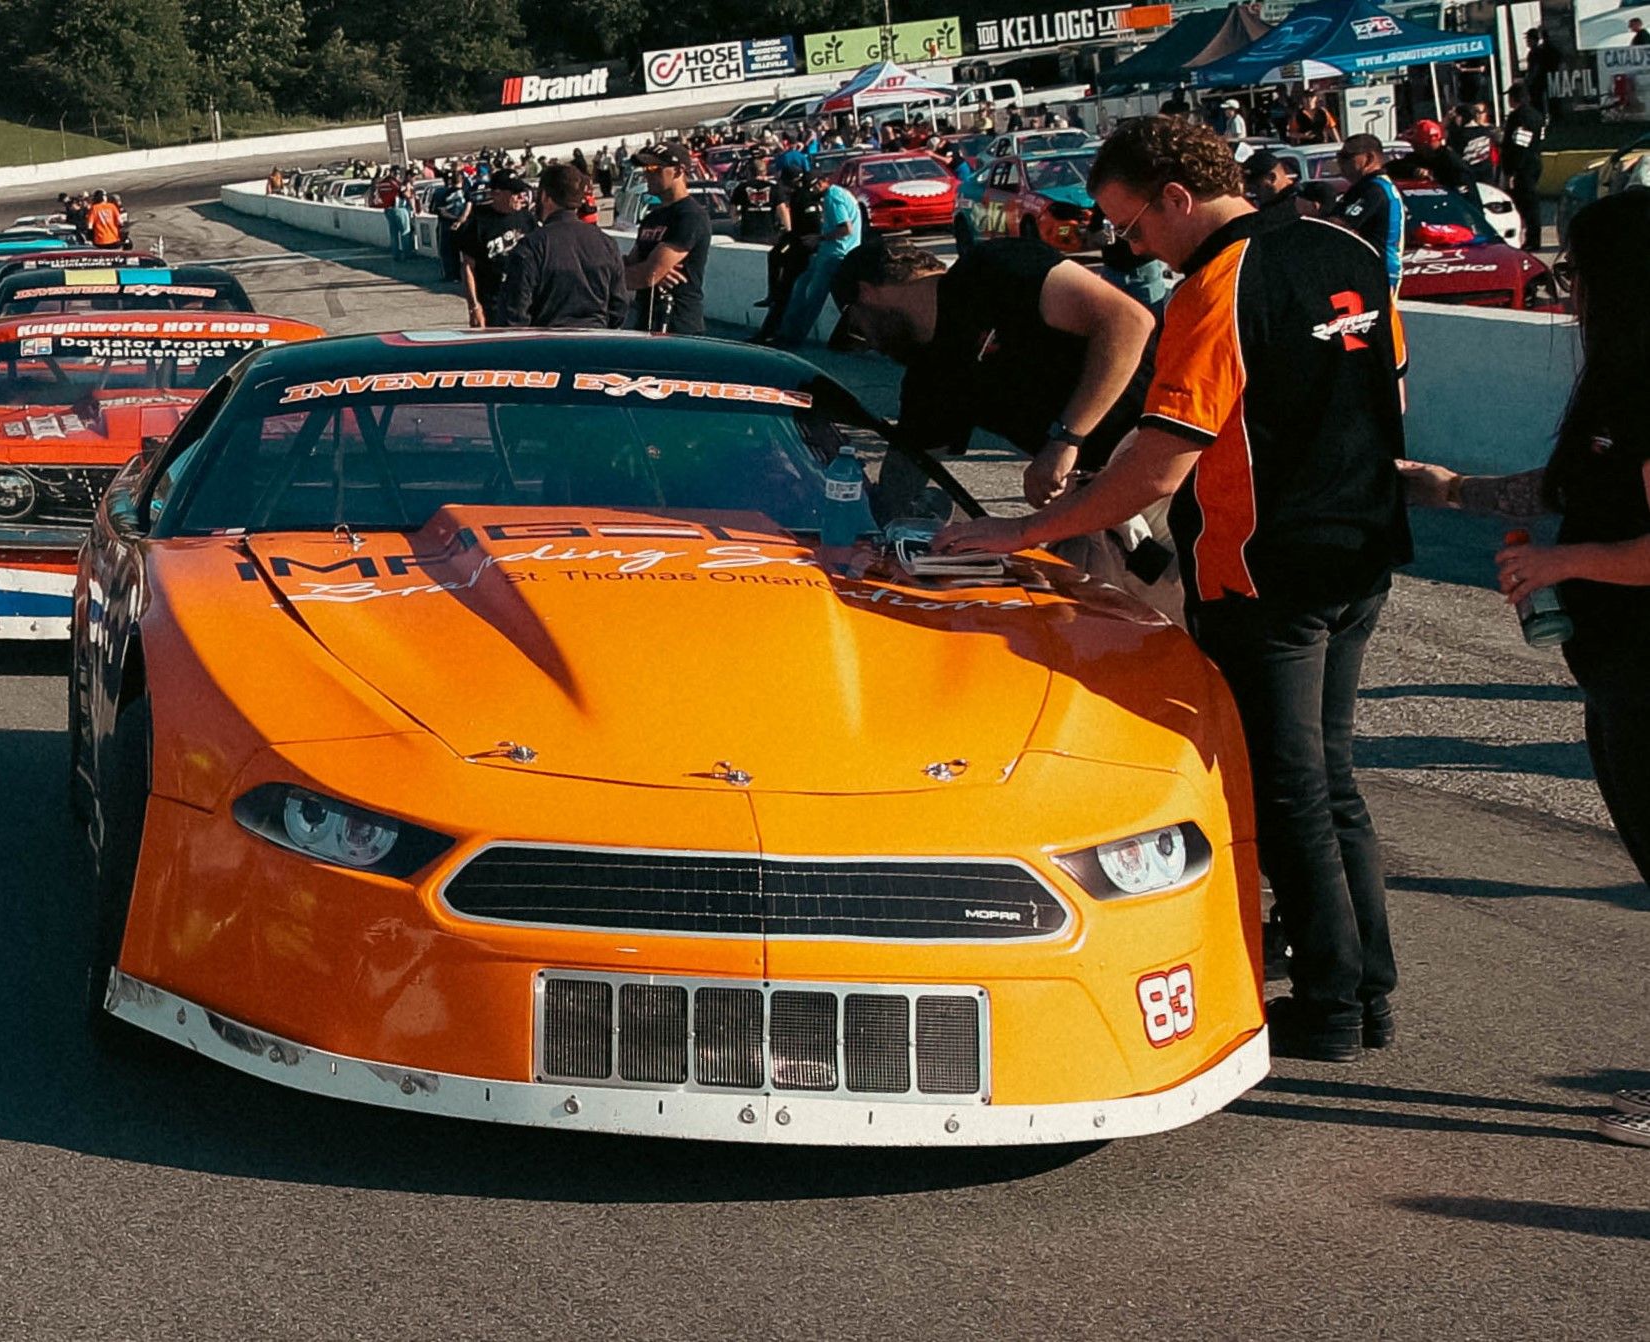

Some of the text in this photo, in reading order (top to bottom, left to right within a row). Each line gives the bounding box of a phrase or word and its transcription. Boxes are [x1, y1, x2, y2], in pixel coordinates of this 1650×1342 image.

[977, 25, 999, 46] 100
[1001, 9, 1095, 48] KELLOGG
[684, 45, 740, 67] HOSE
[811, 40, 845, 66] GFL
[686, 62, 741, 83] TECH
[521, 67, 609, 104] Brandt
[1421, 263, 1499, 276] Spice
[17, 321, 270, 338] Knightworks HOT RODS
[60, 338, 254, 351] Doxtator Property
[92, 347, 226, 358] Maintenance
[279, 369, 813, 408] INVENTORY EXPRESS
[505, 569, 548, 583] St.
[558, 569, 698, 584] Thomas
[965, 908, 1021, 921] MOPAR
[1136, 963, 1197, 1049] 83
